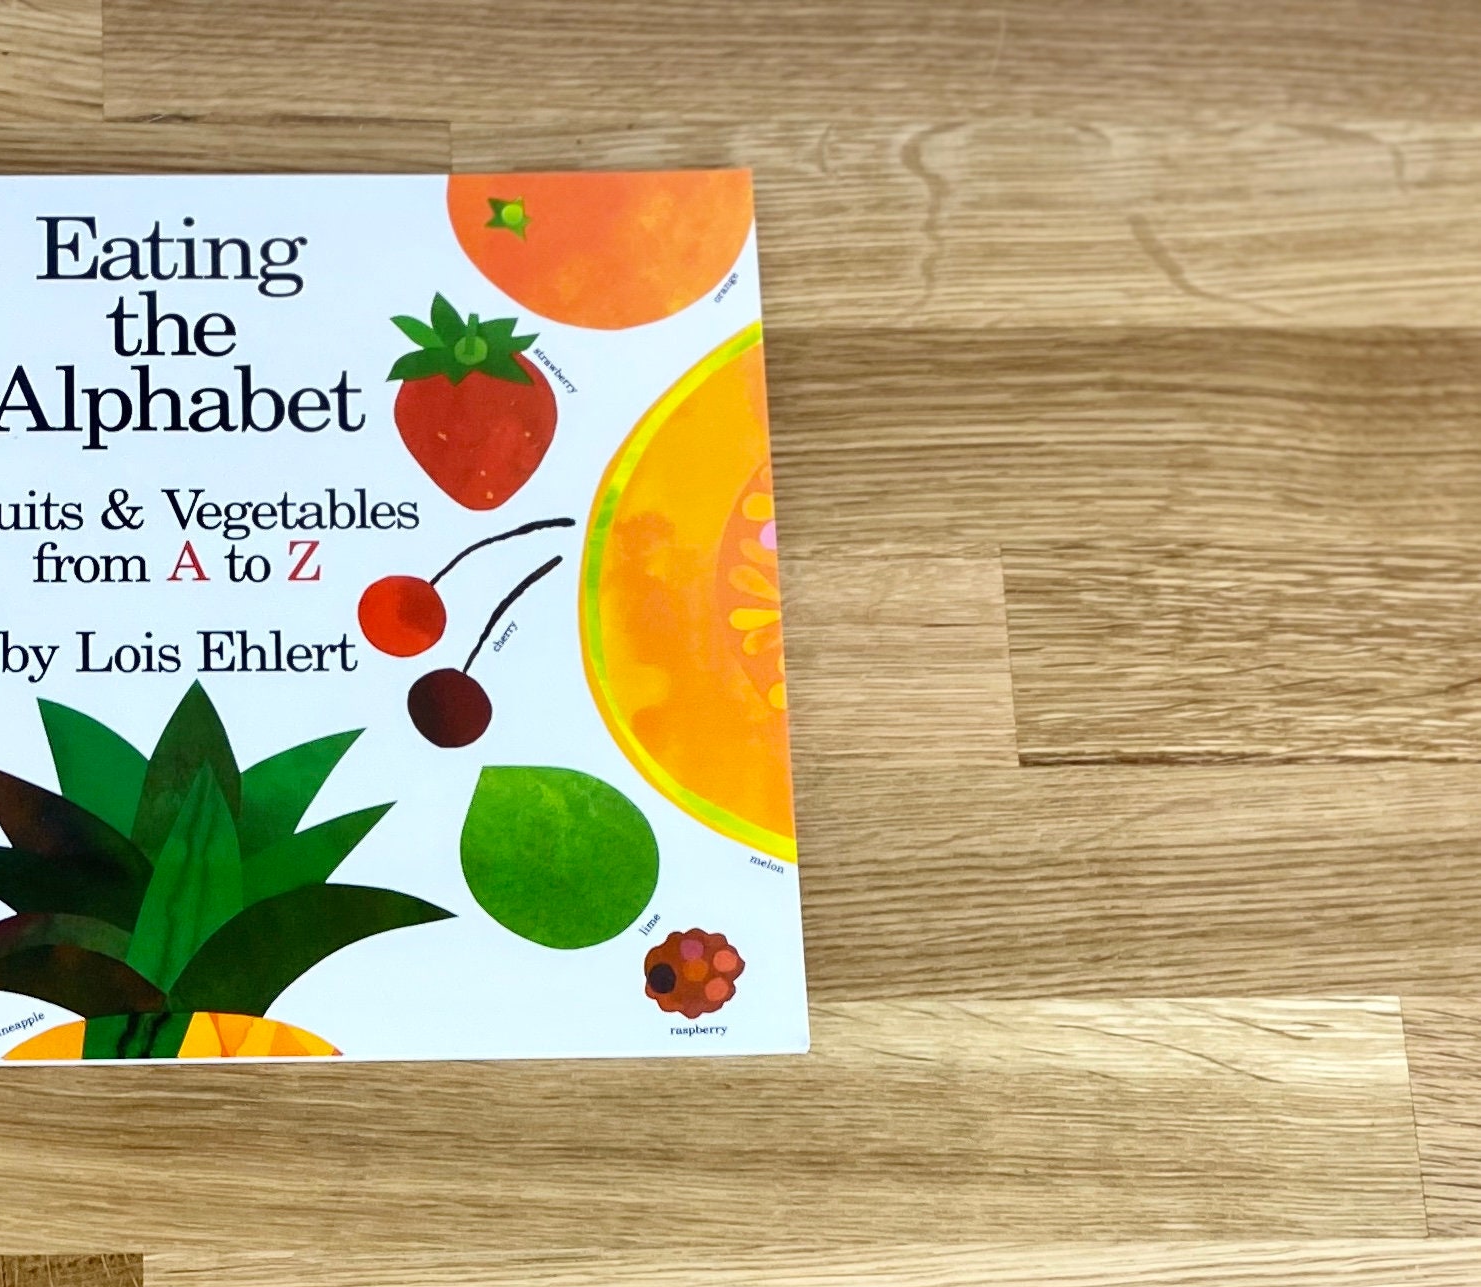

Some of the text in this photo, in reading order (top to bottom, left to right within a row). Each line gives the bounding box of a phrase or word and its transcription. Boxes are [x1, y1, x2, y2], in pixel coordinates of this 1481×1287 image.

[35, 215, 308, 299] Eating
[713, 271, 739, 304] orange
[106, 289, 237, 357] the
[532, 347, 578, 396] strawberry
[100, 487, 145, 531] &
[160, 487, 420, 541] Vegetables
[32, 540, 322, 584] from A to Z
[75, 630, 182, 674] Lois
[197, 630, 359, 674] Ehlert
[492, 619, 518, 653] cherry
[748, 855, 786, 874] melon
[637, 912, 662, 938] lime
[669, 1023, 728, 1038] raspberry
